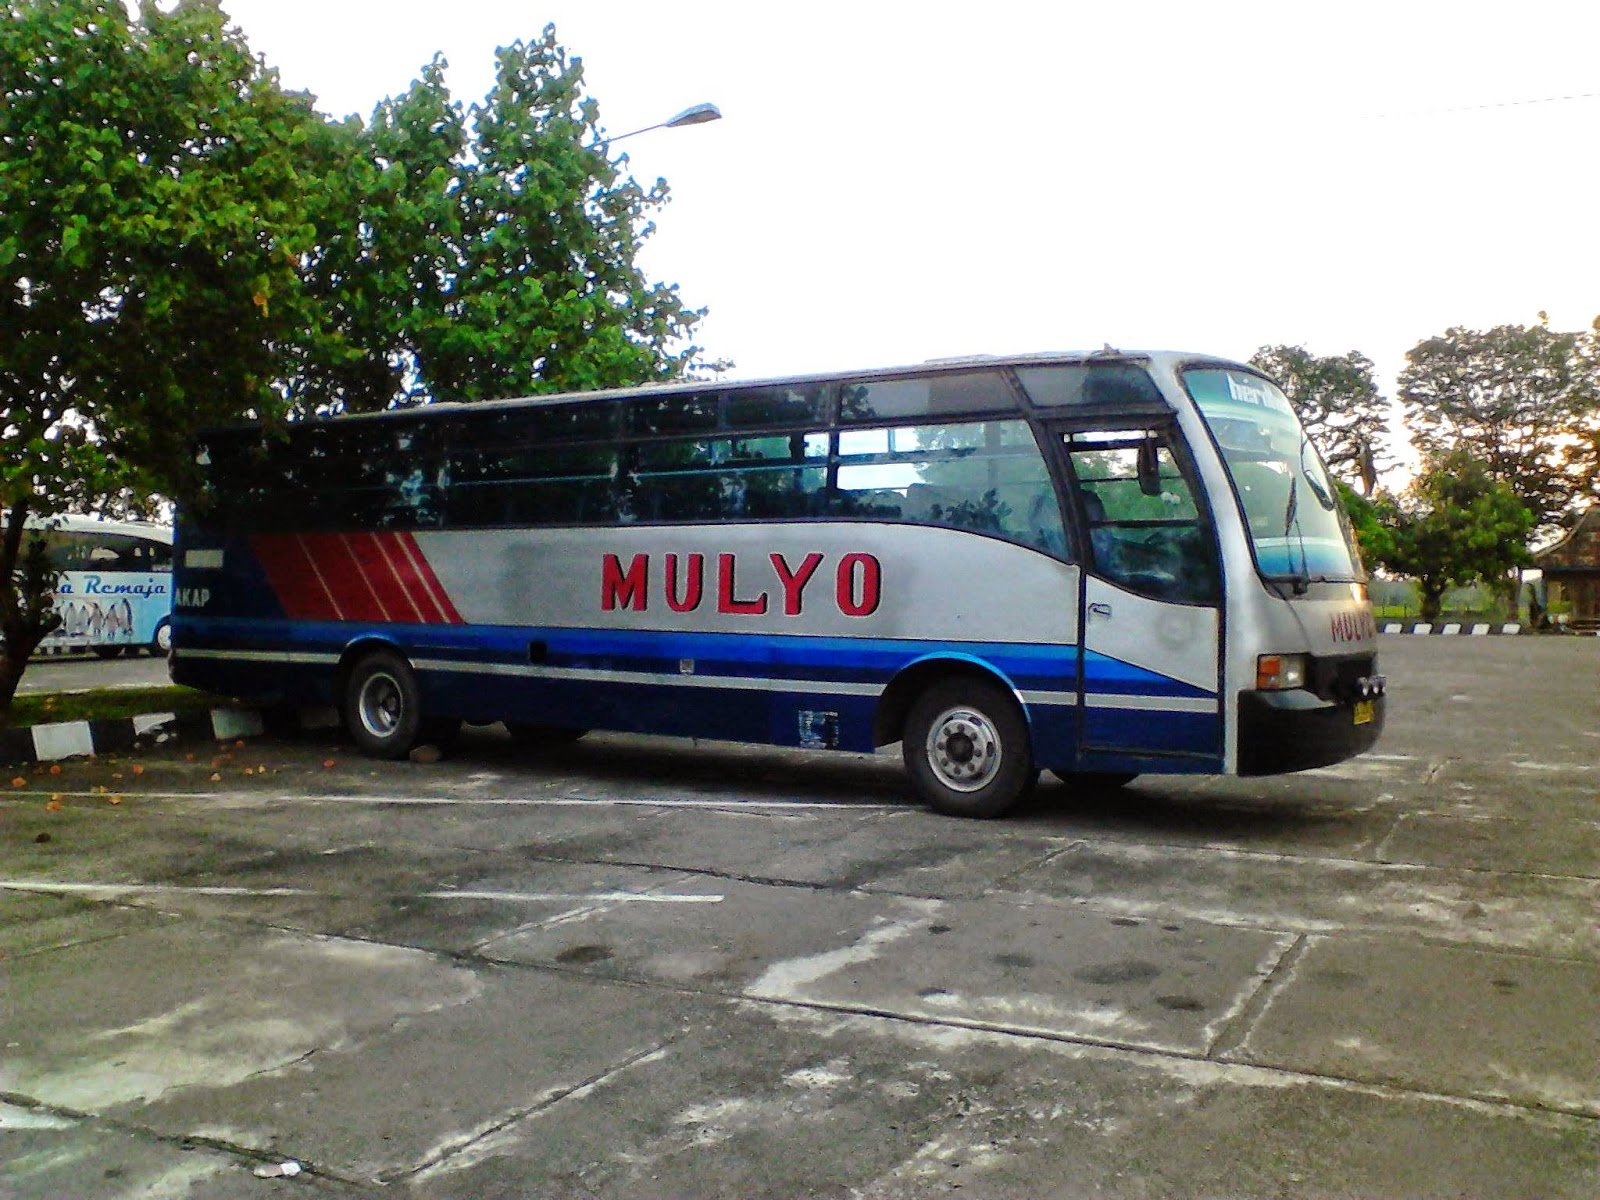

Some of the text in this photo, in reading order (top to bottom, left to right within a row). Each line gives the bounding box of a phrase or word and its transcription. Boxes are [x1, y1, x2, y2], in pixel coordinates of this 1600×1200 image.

[84, 574, 167, 598] Remaja
[600, 552, 882, 616] MULYO
[175, 587, 210, 607] AKAP
